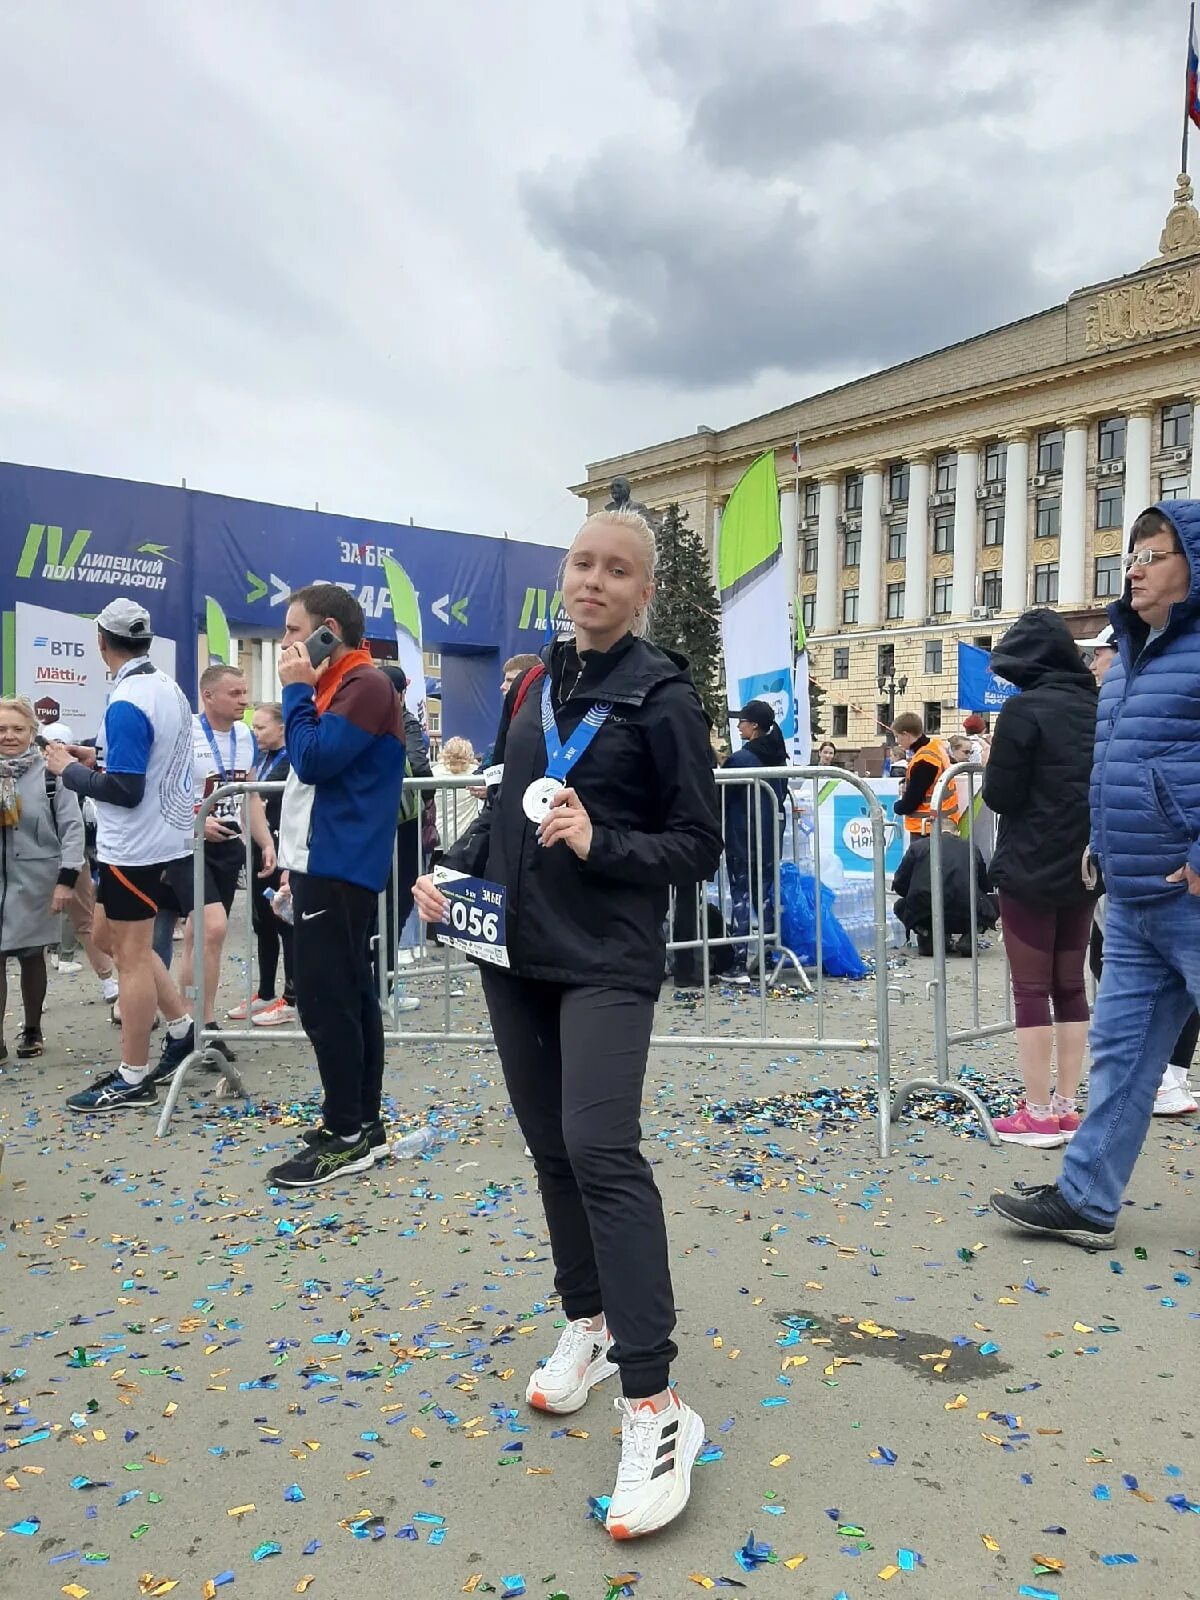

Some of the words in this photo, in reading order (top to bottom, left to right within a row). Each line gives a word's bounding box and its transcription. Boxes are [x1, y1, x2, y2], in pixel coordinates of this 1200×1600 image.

[16, 523, 92, 581] IV
[81, 553, 163, 574] ЛИПЕЦКИЙ
[42, 563, 166, 590] ПОЛУМАРАФОН
[50, 641, 85, 657] ВТБ
[37, 666, 75, 681] Mätti
[37, 707, 58, 716] ТРИО
[446, 899, 499, 943] 056
